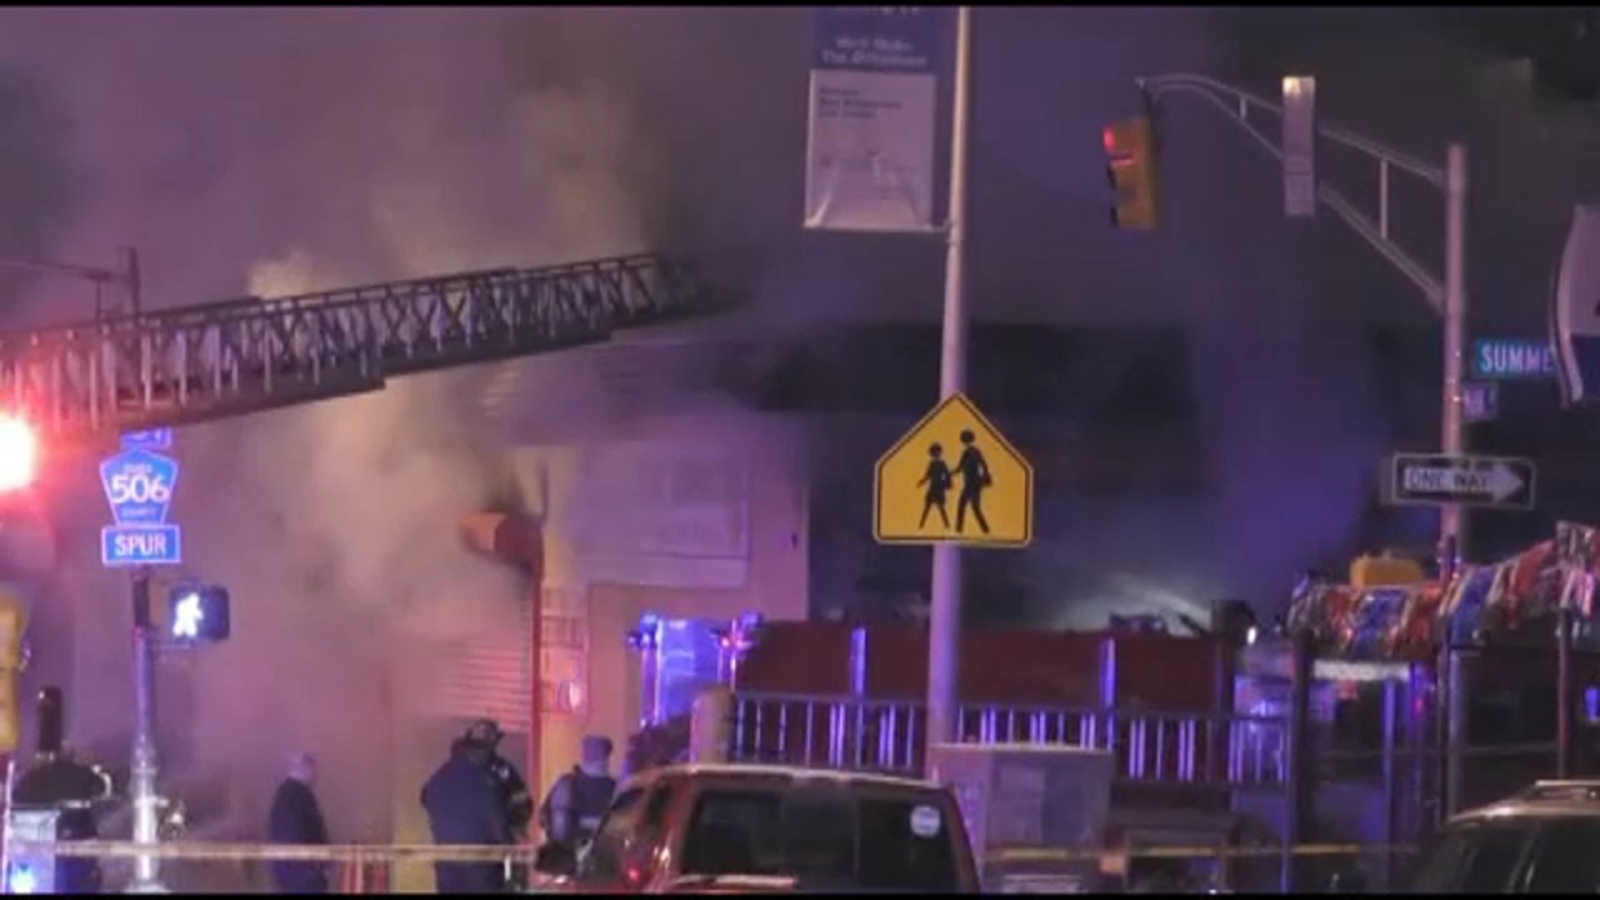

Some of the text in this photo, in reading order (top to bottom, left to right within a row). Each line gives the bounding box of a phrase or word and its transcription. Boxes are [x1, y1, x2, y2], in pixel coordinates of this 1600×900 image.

[1480, 344, 1553, 373] SUMME
[111, 474, 169, 504] 506
[1408, 469, 1491, 490] ONE WAY
[114, 533, 167, 557] SPUR
